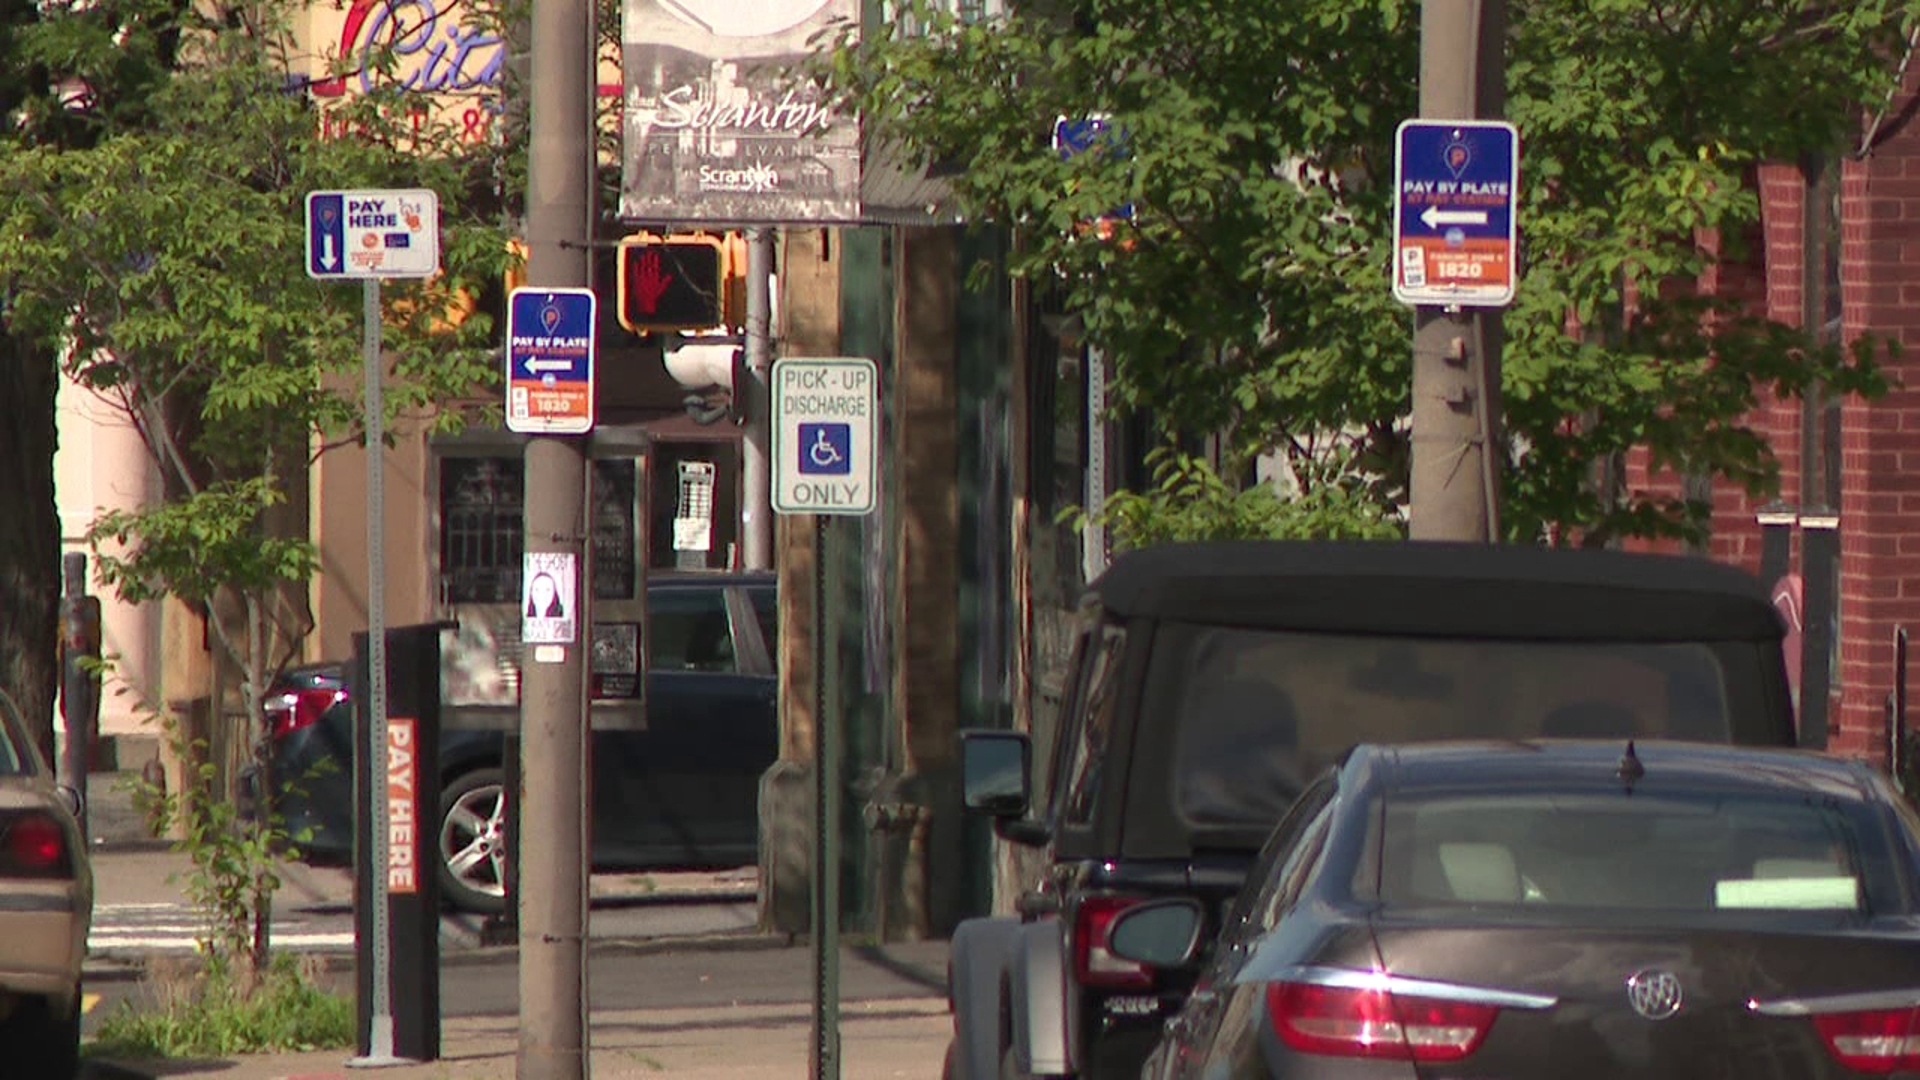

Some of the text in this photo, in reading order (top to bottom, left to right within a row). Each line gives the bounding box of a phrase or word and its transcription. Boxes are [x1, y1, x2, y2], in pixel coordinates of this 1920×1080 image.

[359, 0, 503, 98] Cit
[652, 84, 829, 129] Scranton
[1403, 181, 1508, 196] PAY BY PLATE
[348, 200, 385, 213] PAY
[348, 214, 398, 228] HERE
[1438, 262, 1482, 277] 1820
[513, 336, 588, 348] PAY BY PLATE
[784, 395, 866, 416] DISCHARGE
[792, 483, 860, 505] ONLY
[387, 724, 413, 887] PAY HERE
